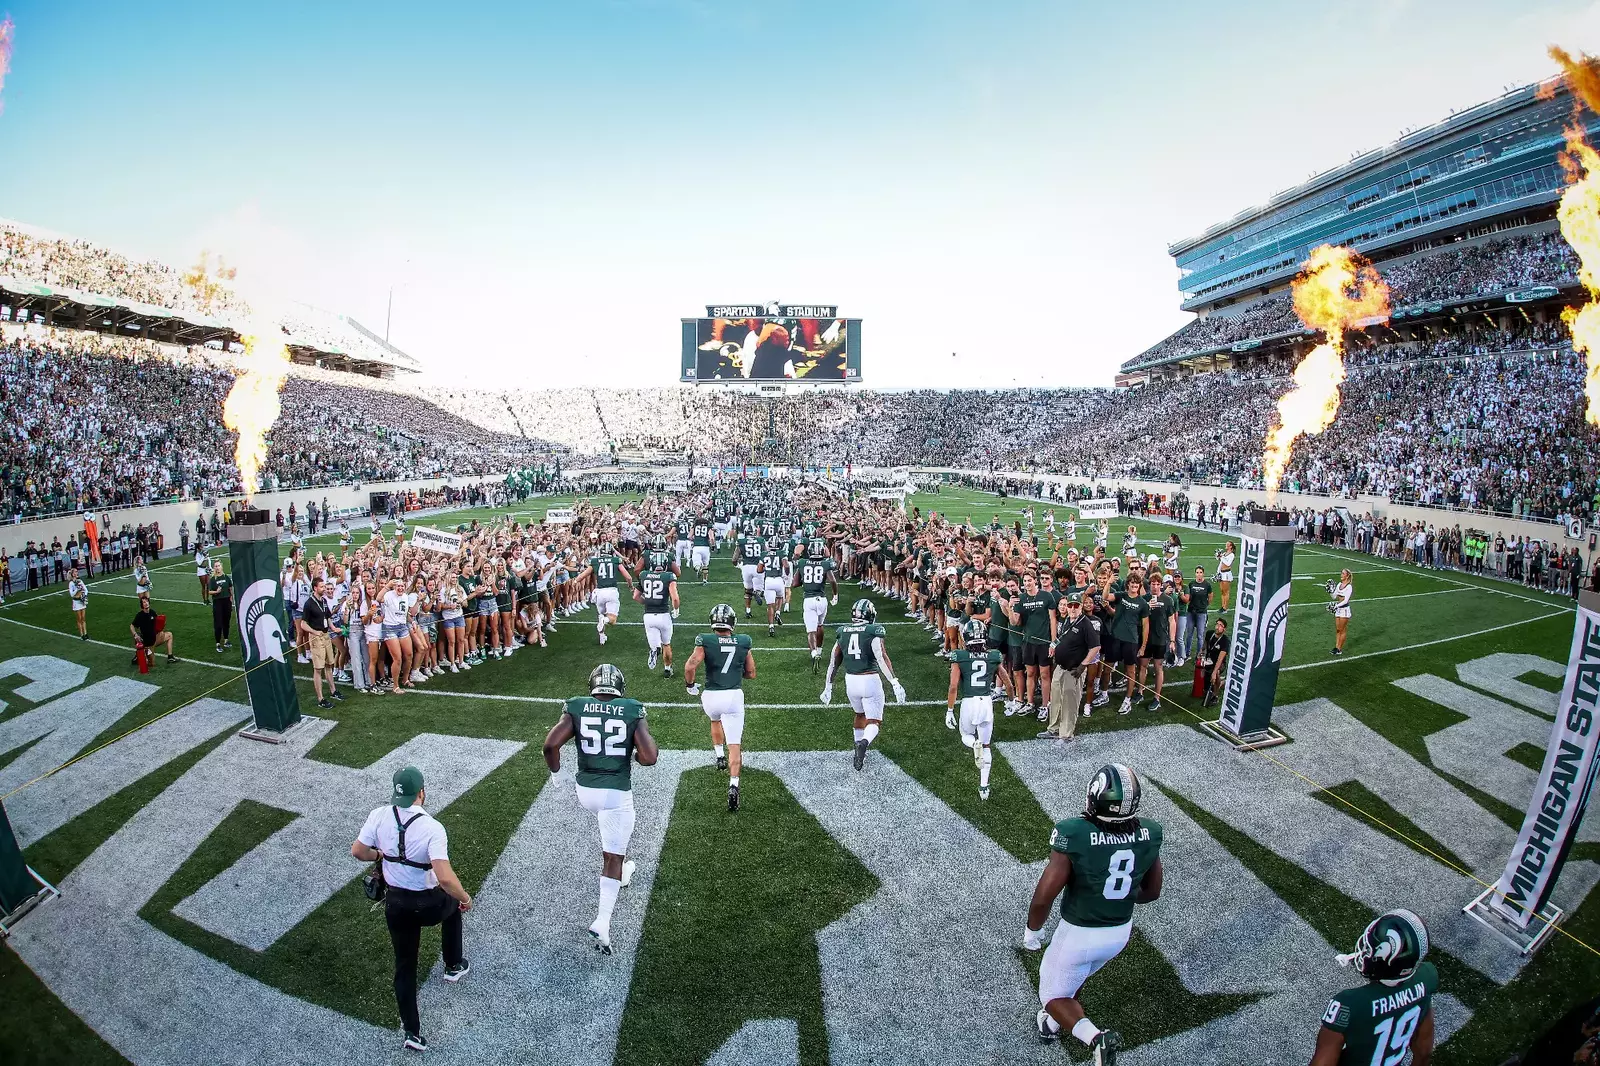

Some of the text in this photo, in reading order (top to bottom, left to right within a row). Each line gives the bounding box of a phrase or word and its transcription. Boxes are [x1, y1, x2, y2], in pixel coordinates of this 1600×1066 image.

[713, 306, 830, 317] SPARTAN STADIUM
[414, 529, 461, 547] MICHIGAN STATE
[695, 525, 708, 537] 69
[762, 524, 775, 536] 76
[745, 543, 761, 557] 58
[598, 562, 614, 579] 41
[764, 556, 780, 571] 24
[803, 565, 824, 584] 88
[643, 579, 664, 600] 92
[1223, 539, 1260, 727] MICHIGAN STATE
[847, 633, 862, 660] 4
[720, 646, 736, 674] 7
[970, 660, 987, 687] 2
[583, 703, 625, 716] ADELEYE
[580, 716, 627, 756] 52
[1050, 828, 1059, 845] 8
[1138, 828, 1150, 841] JR
[1502, 739, 1584, 918] MICHIGAN
[1102, 849, 1136, 900] 8
[1372, 982, 1425, 1017] FRANKLIN
[1322, 999, 1341, 1024] 19
[1369, 1004, 1422, 1066] 19
